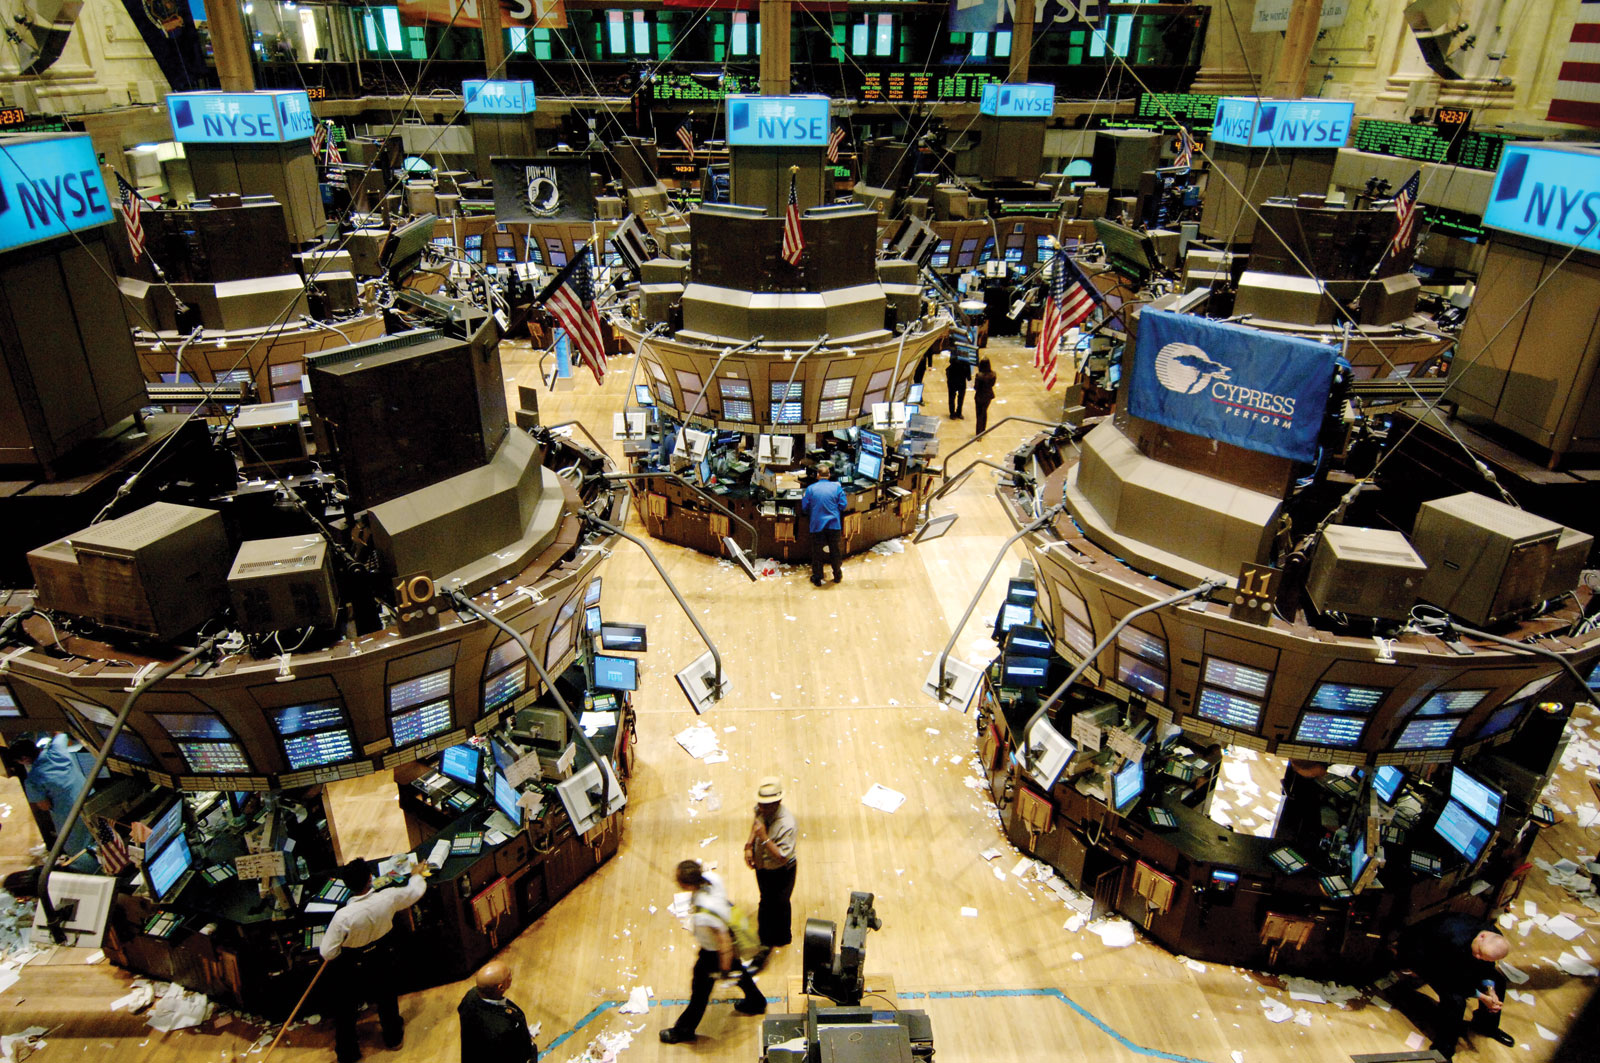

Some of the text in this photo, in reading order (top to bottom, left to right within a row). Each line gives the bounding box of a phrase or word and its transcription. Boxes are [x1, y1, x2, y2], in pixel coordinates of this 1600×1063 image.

[483, 94, 522, 109] NYSE
[1014, 98, 1051, 112] NYSE
[203, 113, 274, 137] NYSE
[290, 110, 313, 132] NYSE
[758, 117, 822, 139] NYSE
[1223, 117, 1251, 139] NYSE
[1440, 110, 1467, 124] 4:23:31
[1280, 120, 1344, 141] NYSE
[16, 169, 106, 230] NYSE
[1524, 182, 1600, 239] NYS
[1211, 381, 1296, 416] CYPRESS
[1225, 406, 1292, 430] PERFORM
[396, 575, 434, 608] 10
[1241, 569, 1272, 599] 11
